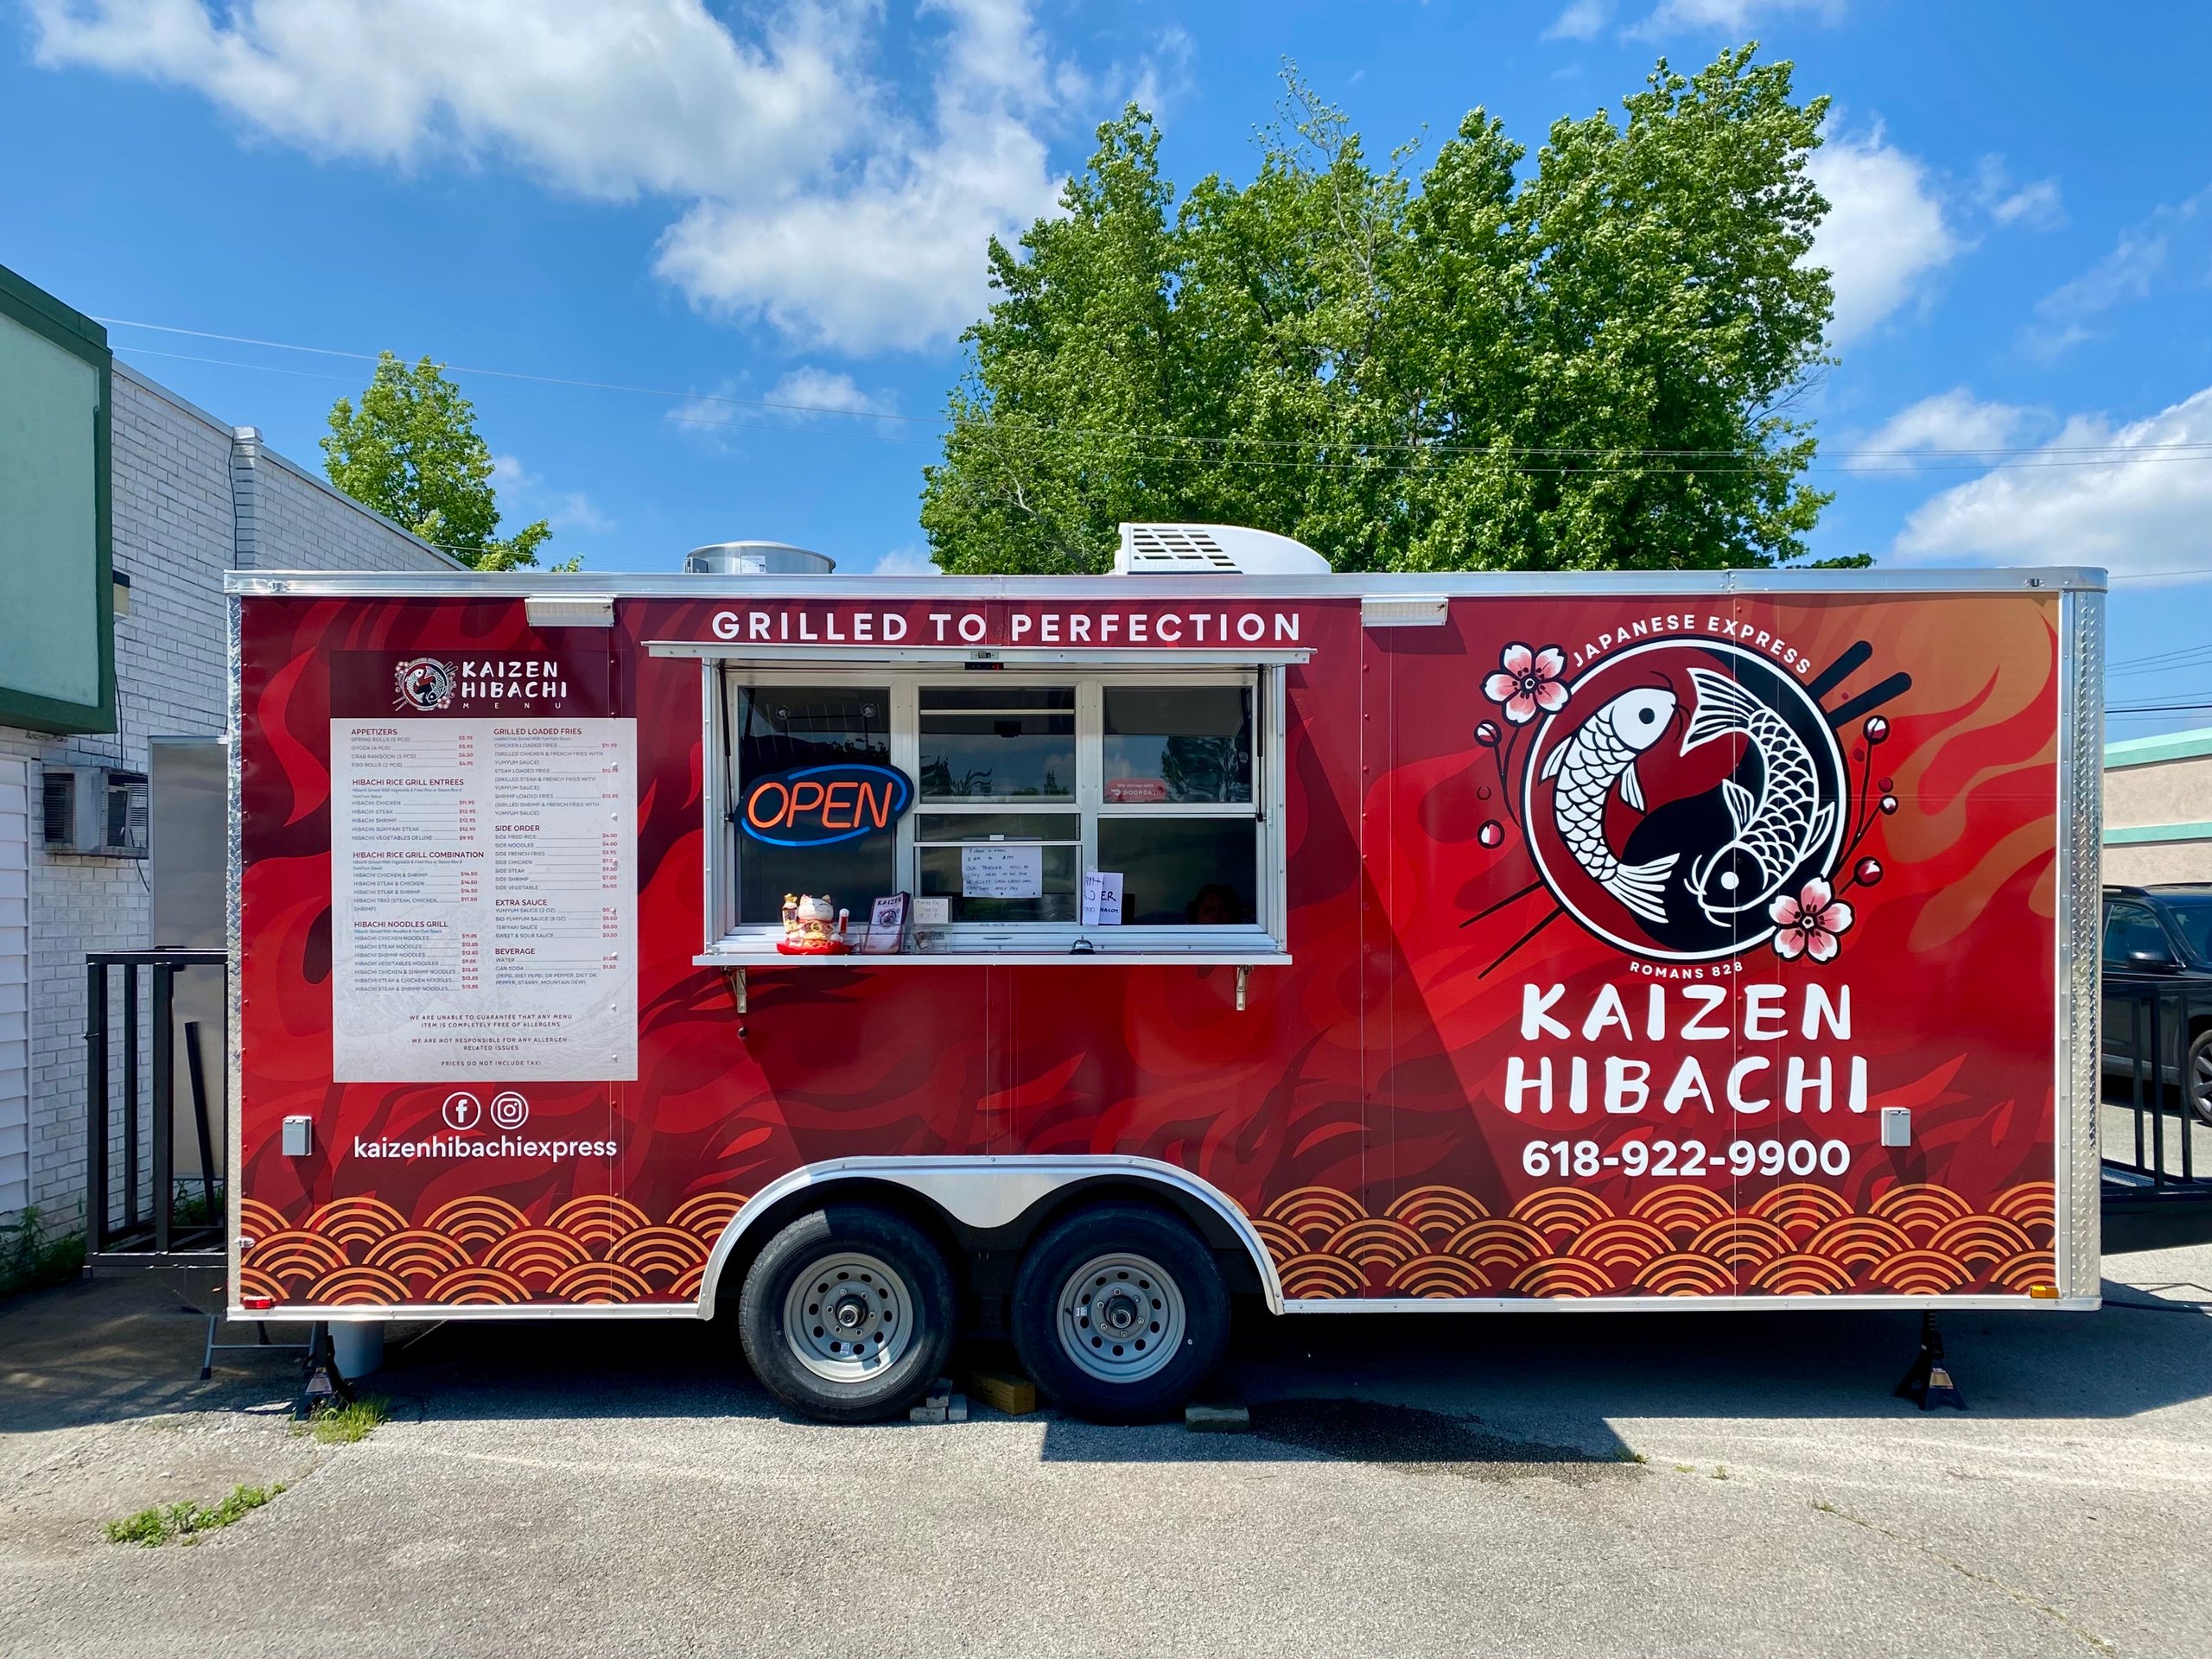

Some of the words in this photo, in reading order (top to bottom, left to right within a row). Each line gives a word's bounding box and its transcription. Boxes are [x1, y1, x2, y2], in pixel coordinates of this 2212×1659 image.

[712, 611, 907, 641] GRILLED
[930, 613, 986, 642] TO
[1012, 613, 1300, 642] PERFECTION
[1574, 614, 1695, 667] JAPANESE
[1707, 617, 1812, 674] EXPRESS
[462, 661, 557, 677] KAIZEN
[461, 682, 567, 698] HIBACHI
[747, 781, 893, 828] OPEN
[1630, 961, 1704, 980] ROMANS
[1713, 961, 1743, 977] 828
[1521, 983, 1851, 1041] KAIZEN
[1504, 1056, 1867, 1115] HIBACHI
[354, 1136, 617, 1162] kaizenhibachiexpress
[1522, 1140, 1850, 1177] 618-922-9900
